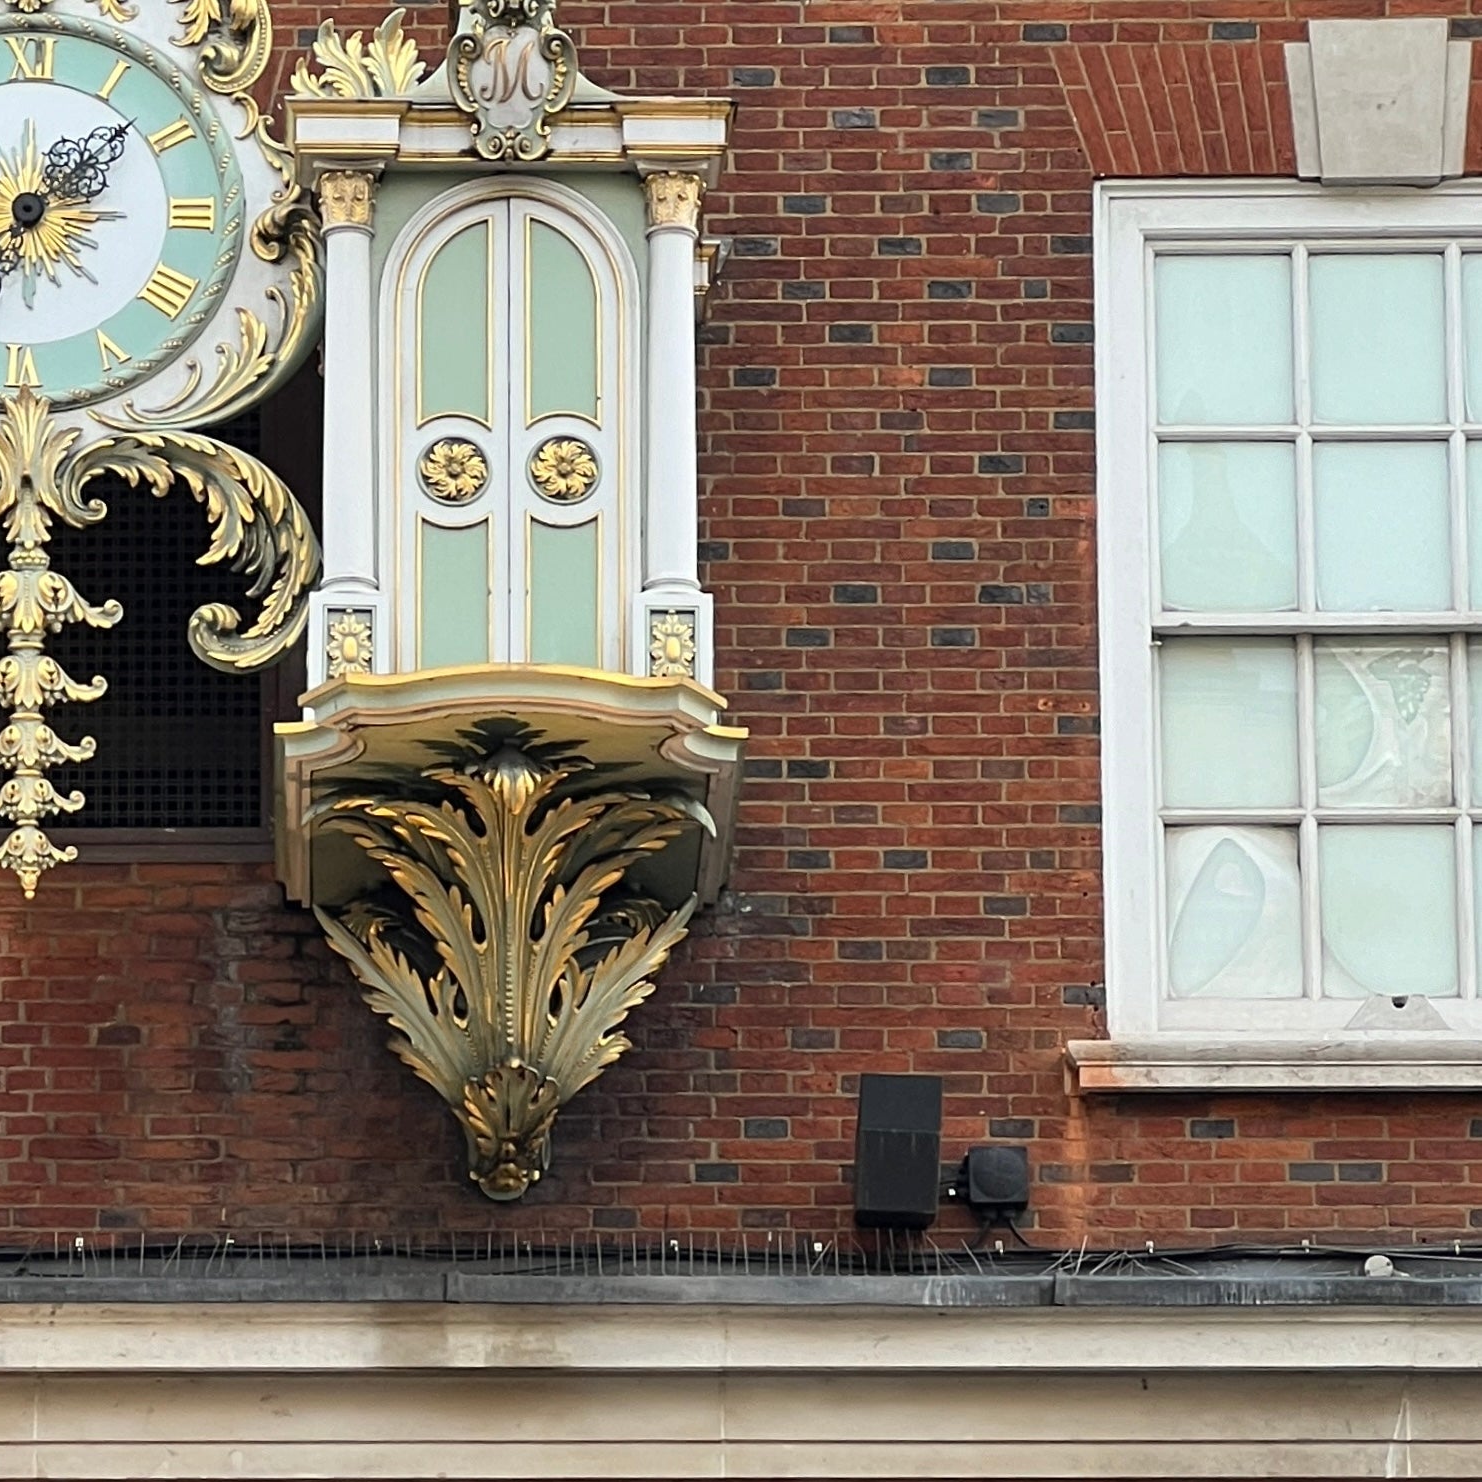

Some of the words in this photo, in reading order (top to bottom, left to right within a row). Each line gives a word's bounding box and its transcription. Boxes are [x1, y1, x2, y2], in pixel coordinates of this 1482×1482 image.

[4, 36, 57, 82] XII
[96, 59, 131, 101] I
[480, 37, 544, 104] M
[146, 115, 197, 156] II
[168, 197, 215, 233] III
[137, 261, 199, 321] IIII
[4, 343, 43, 388] VI
[97, 328, 132, 371] V
